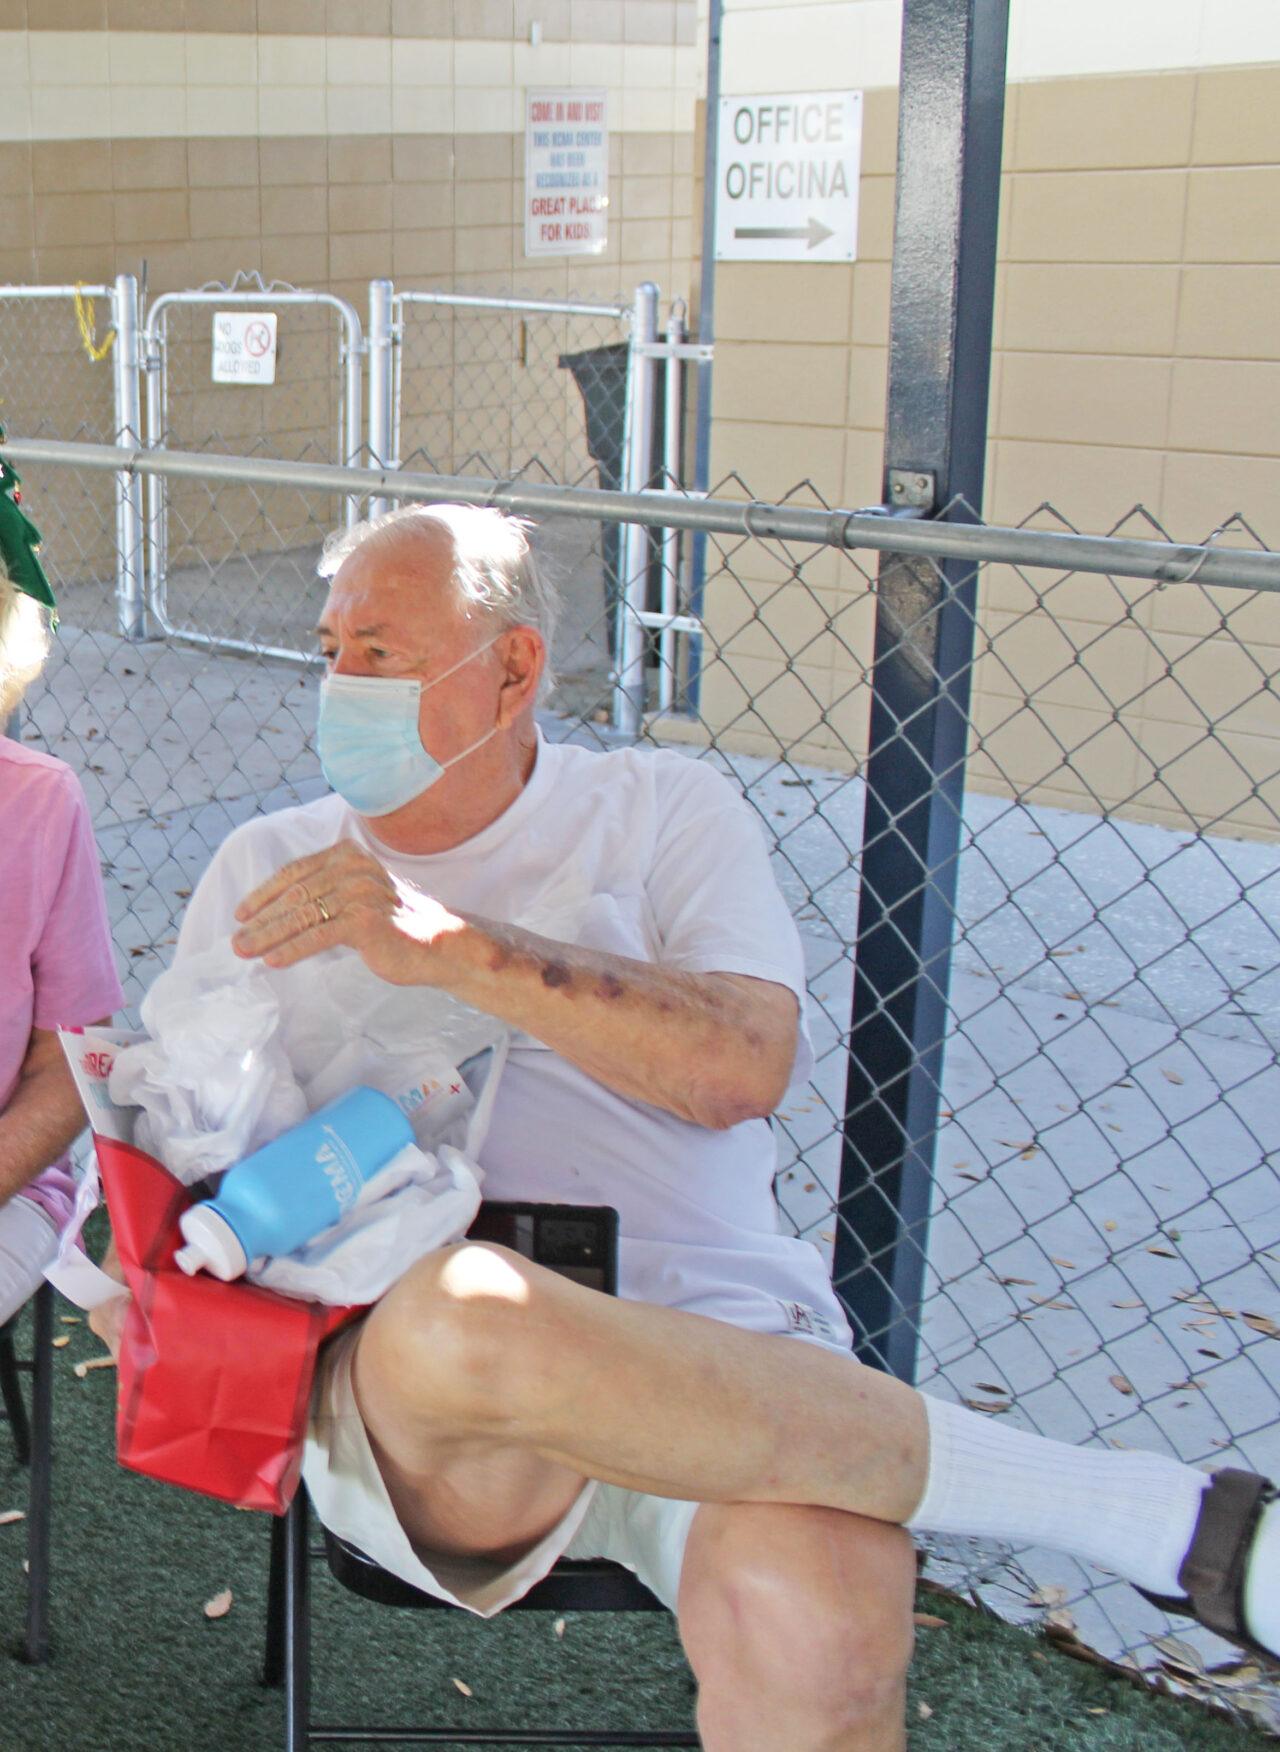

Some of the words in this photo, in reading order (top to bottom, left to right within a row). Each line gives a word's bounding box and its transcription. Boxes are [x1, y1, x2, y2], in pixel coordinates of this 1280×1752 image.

[556, 101, 564, 122] IN
[567, 101, 583, 122] AND
[585, 101, 603, 122] VISIT
[734, 102, 844, 145] OFFICE
[726, 160, 849, 200] OFICINA
[531, 197, 565, 216] GREAT
[569, 196, 602, 214] PLAC
[540, 223, 562, 241] FOR
